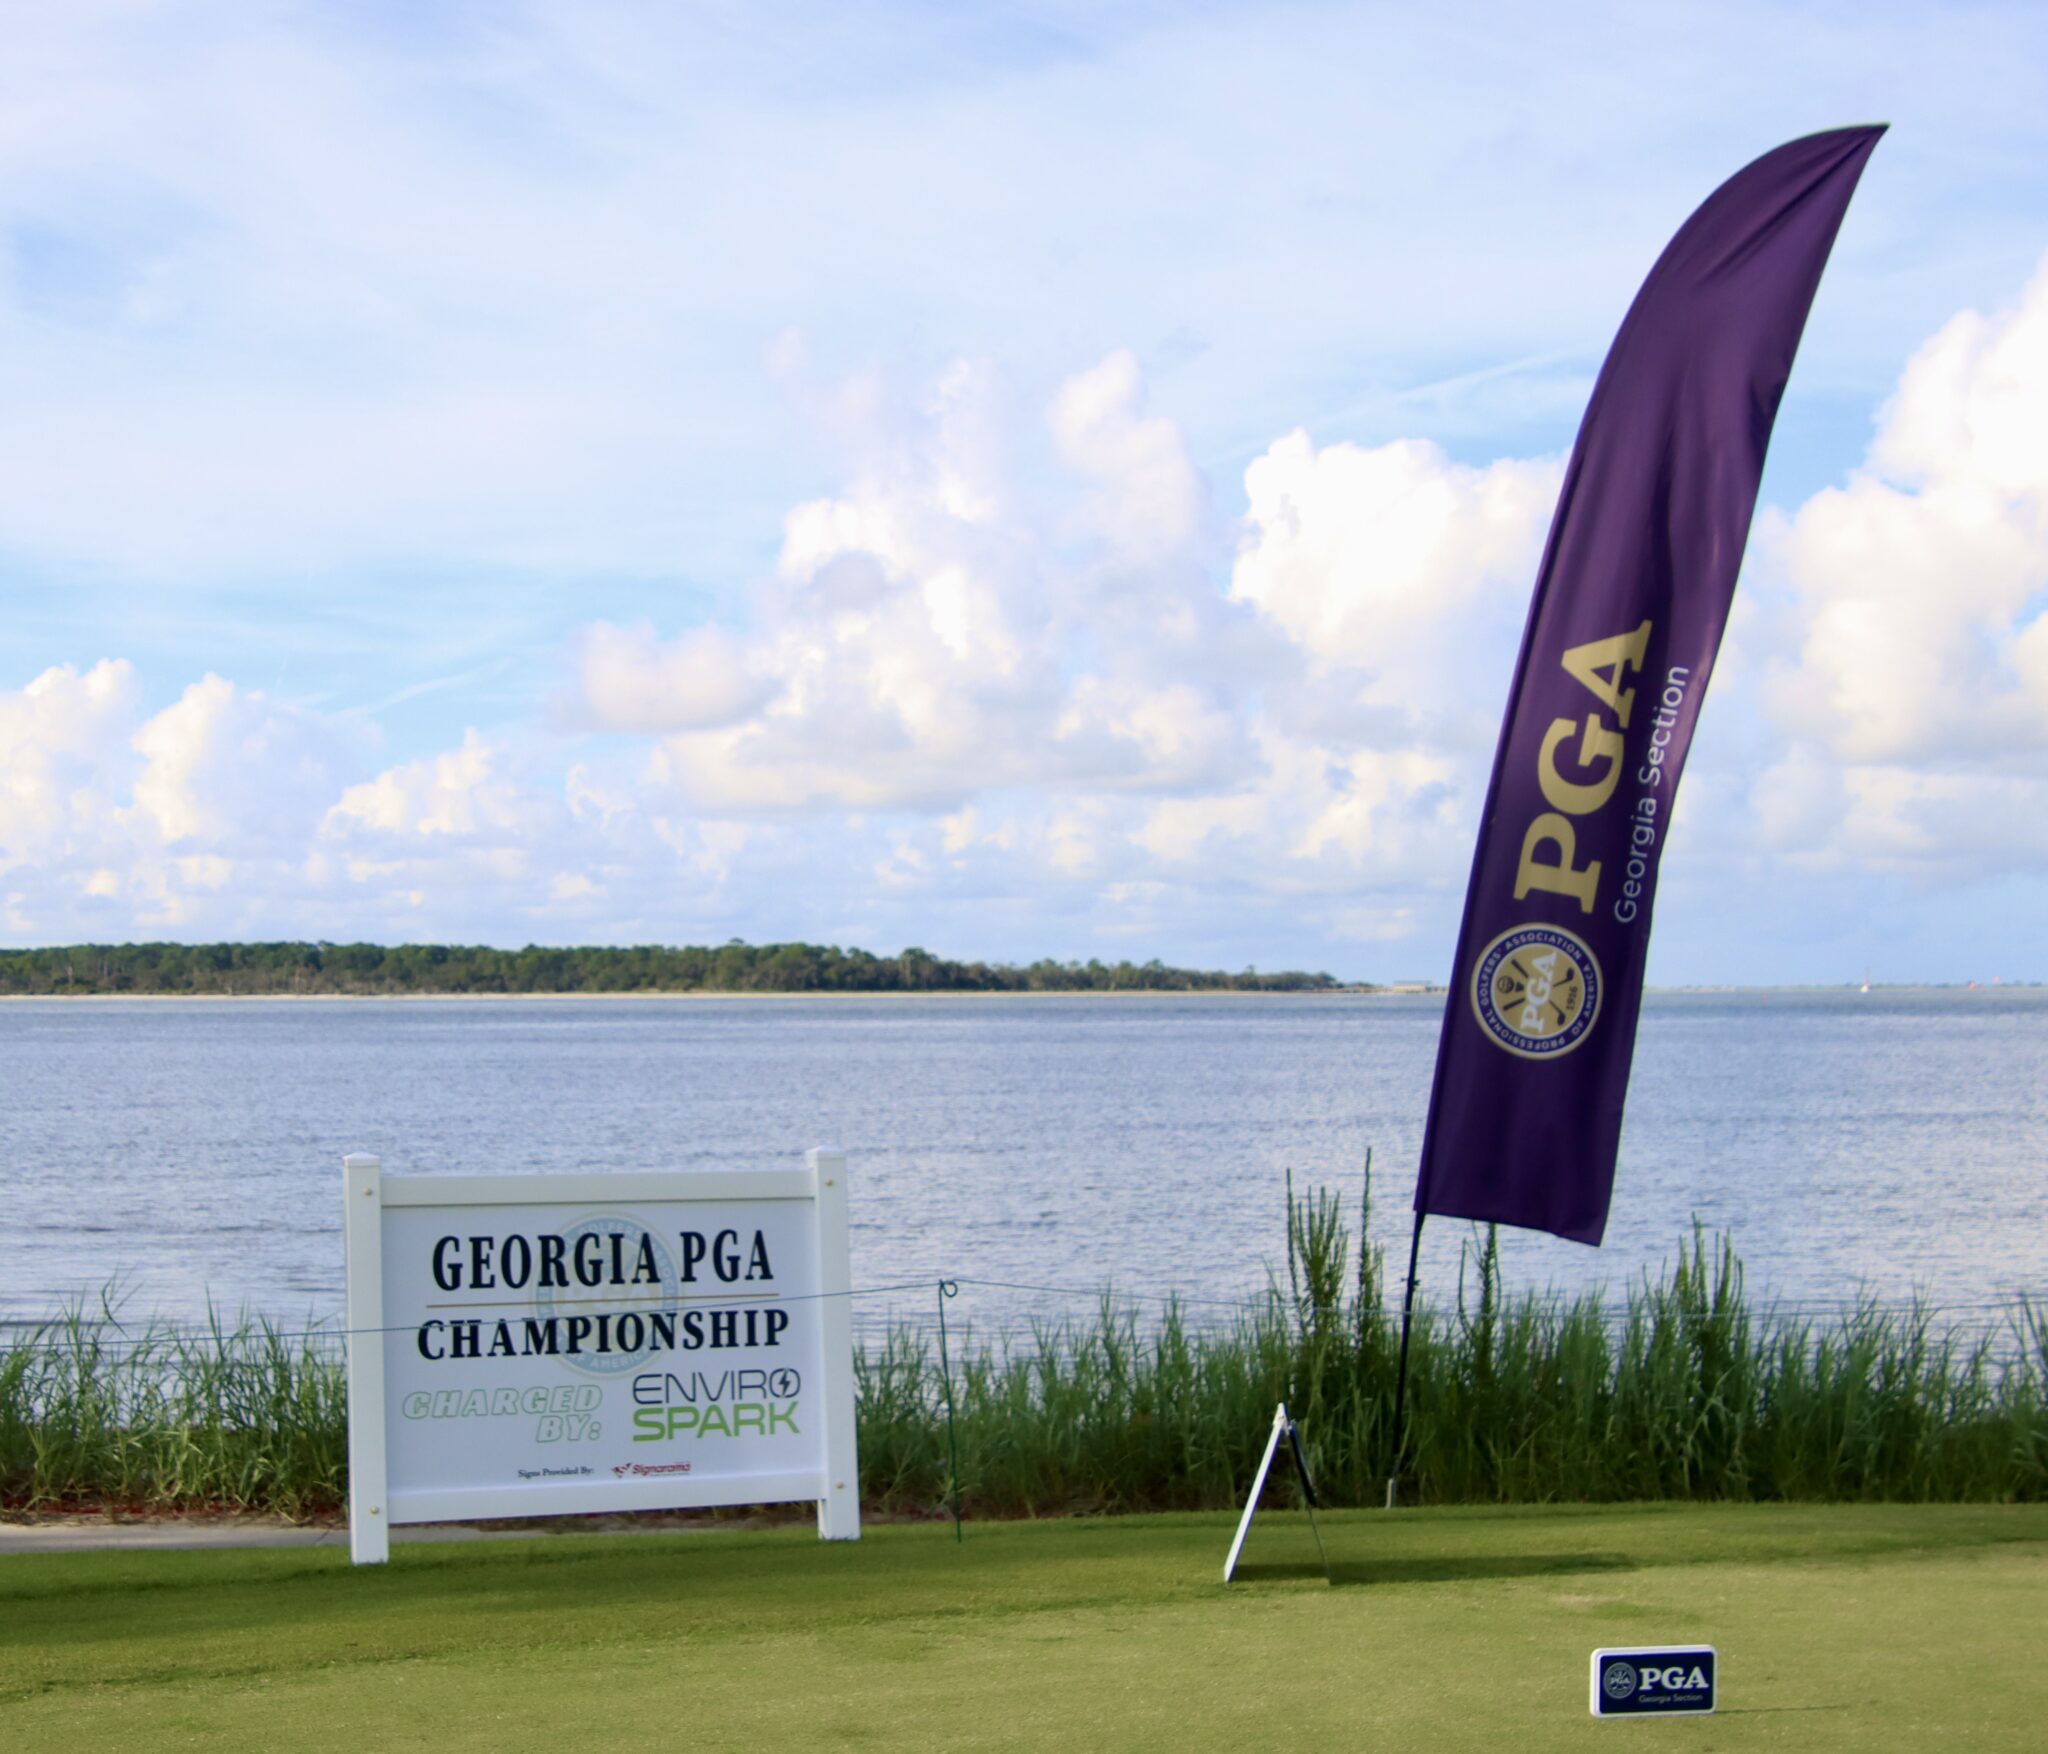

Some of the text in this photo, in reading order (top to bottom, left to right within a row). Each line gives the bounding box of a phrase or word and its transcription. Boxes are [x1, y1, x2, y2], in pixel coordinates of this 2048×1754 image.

[1512, 618, 1653, 915] PGA
[1613, 665, 1690, 924] Georgia Section
[1505, 931, 1582, 960] ASSOCIATION
[1520, 950, 1559, 1034] PGA
[1582, 963, 1596, 1019] AMERICA
[432, 1231, 661, 1292] GEORGIA
[680, 1229, 774, 1284] PGA
[417, 1308, 789, 1360] CHAMPIONSHIP
[401, 1384, 603, 1420] CHARGED
[632, 1368, 801, 1405] ENVIRO
[535, 1414, 602, 1443] BY:
[632, 1401, 800, 1442] SPARK
[517, 1466, 595, 1480] Signs Provided By:
[631, 1462, 691, 1476] Signarama
[1638, 1665, 1710, 1691] PGA
